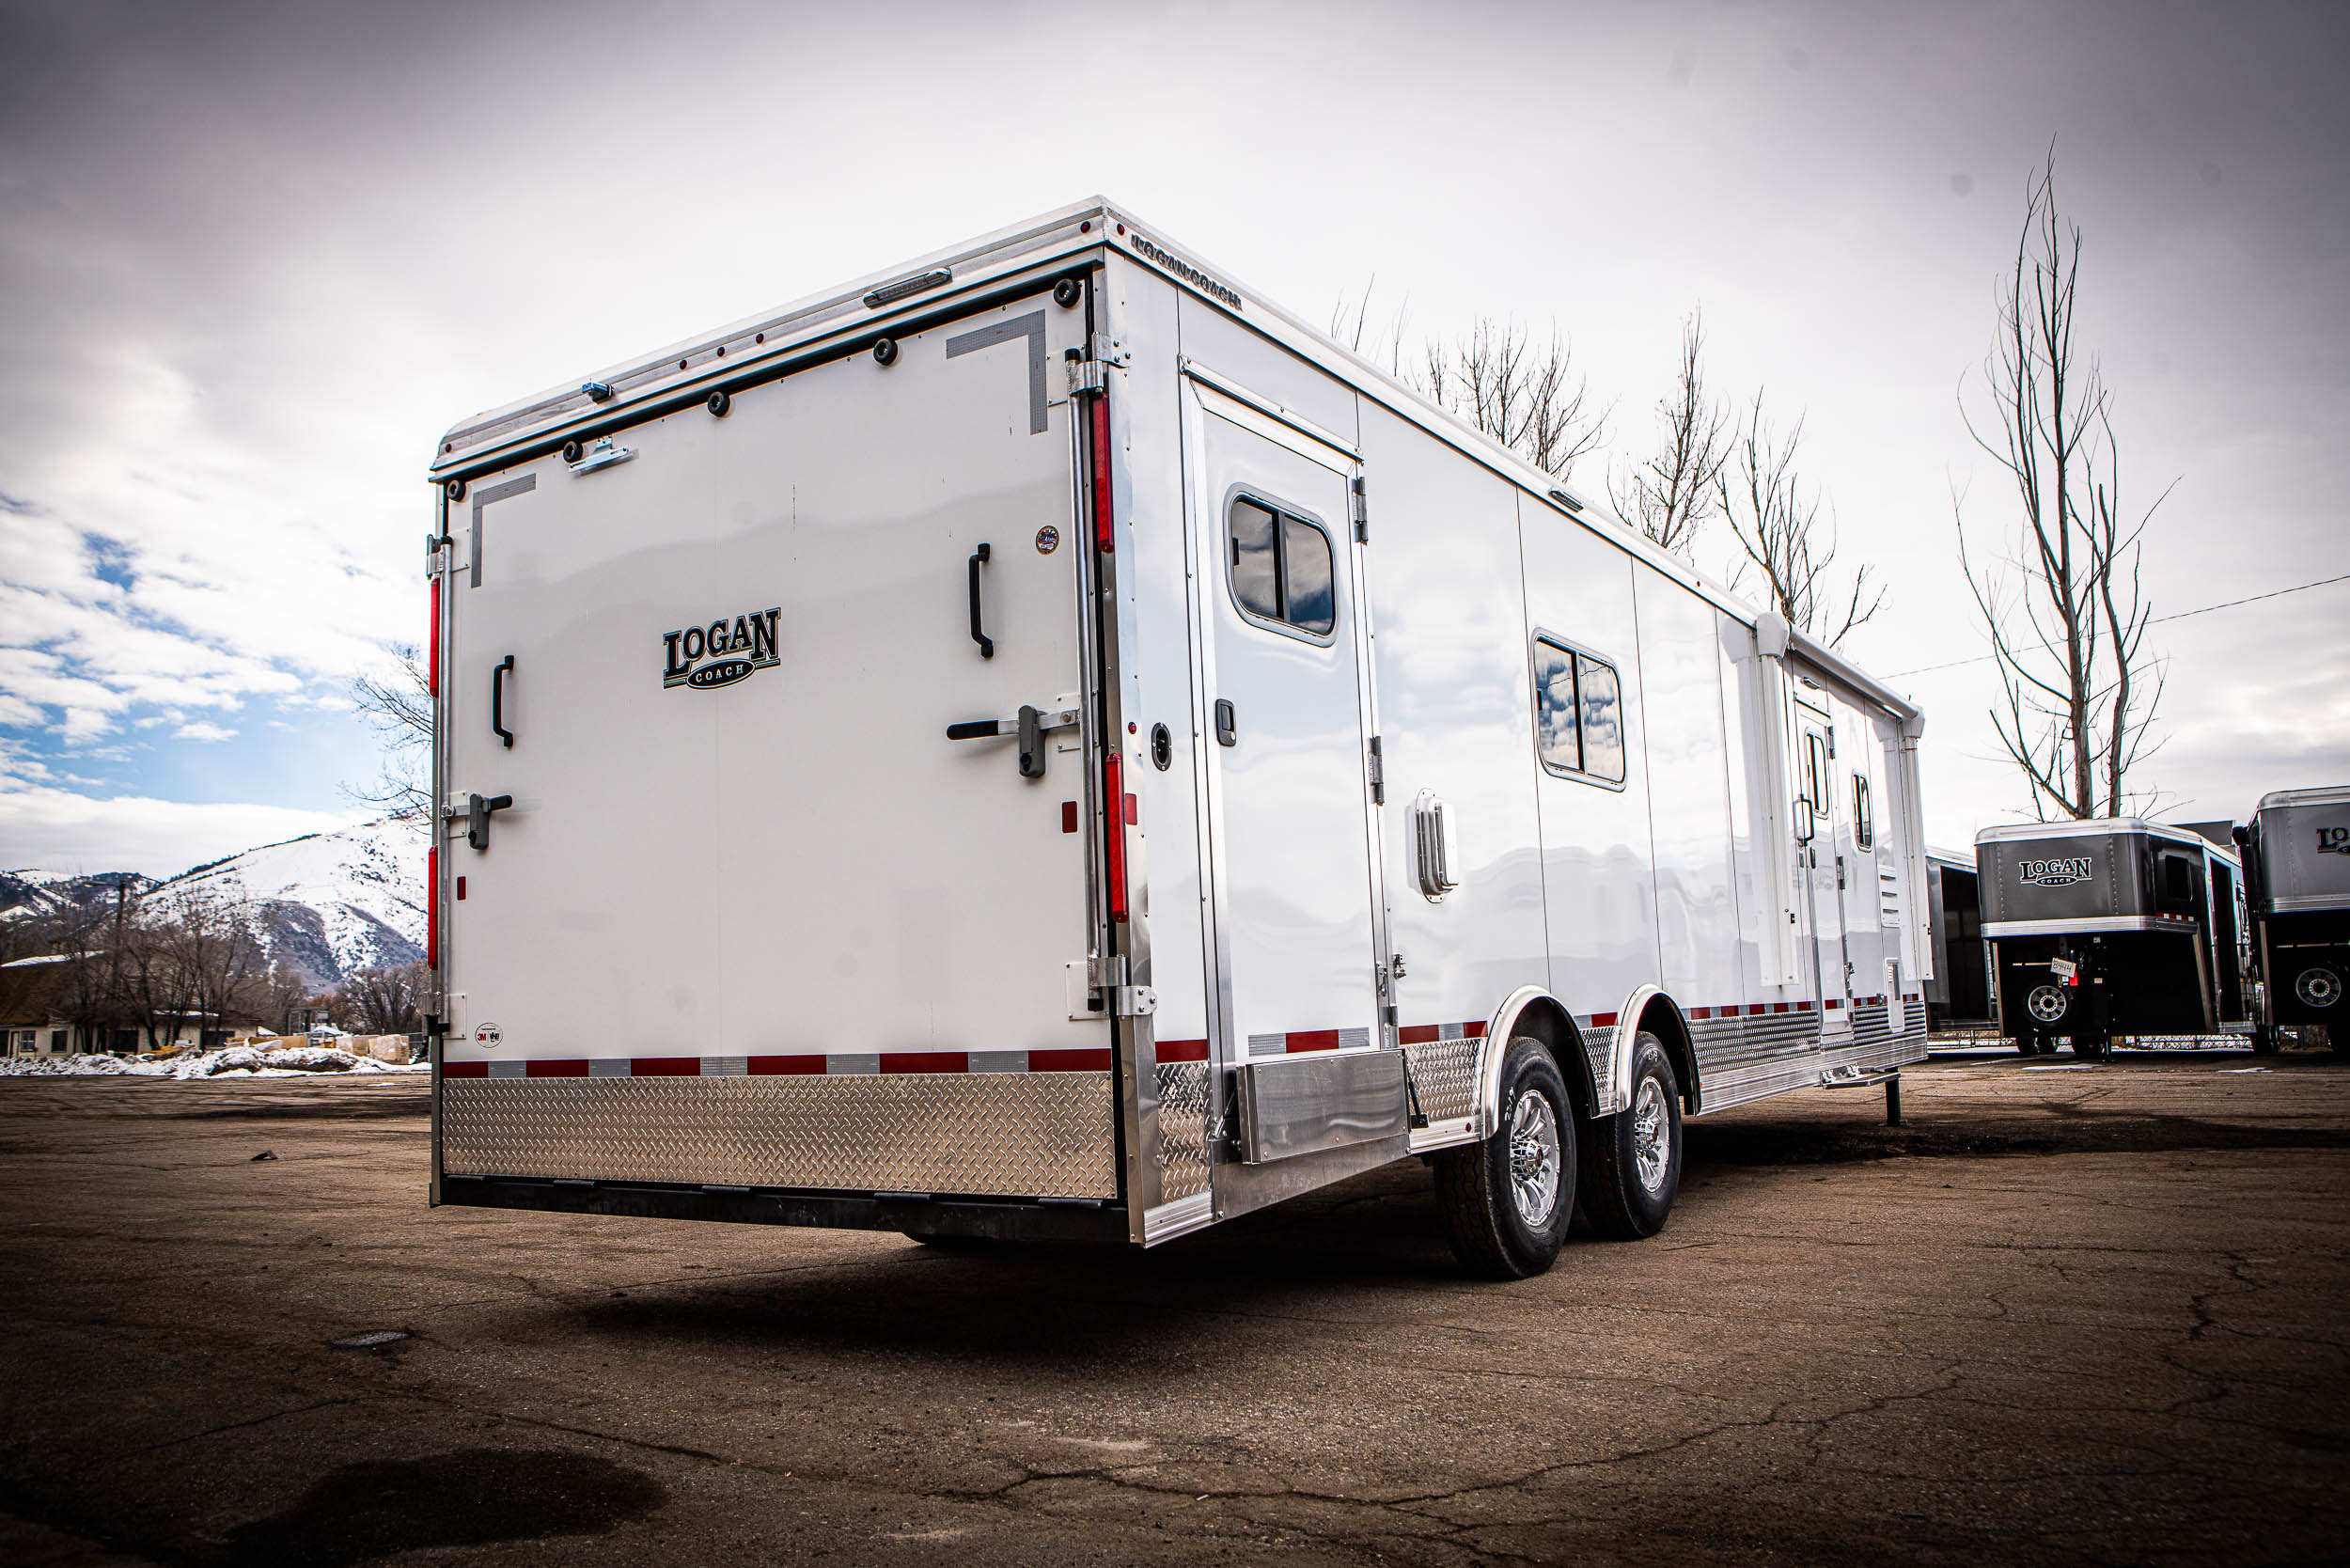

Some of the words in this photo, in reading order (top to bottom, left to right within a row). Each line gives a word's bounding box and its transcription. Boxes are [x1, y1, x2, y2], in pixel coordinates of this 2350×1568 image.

[663, 606, 781, 681] LOGAN
[696, 664, 744, 682] COACH
[2019, 857, 2092, 881] LOGAN
